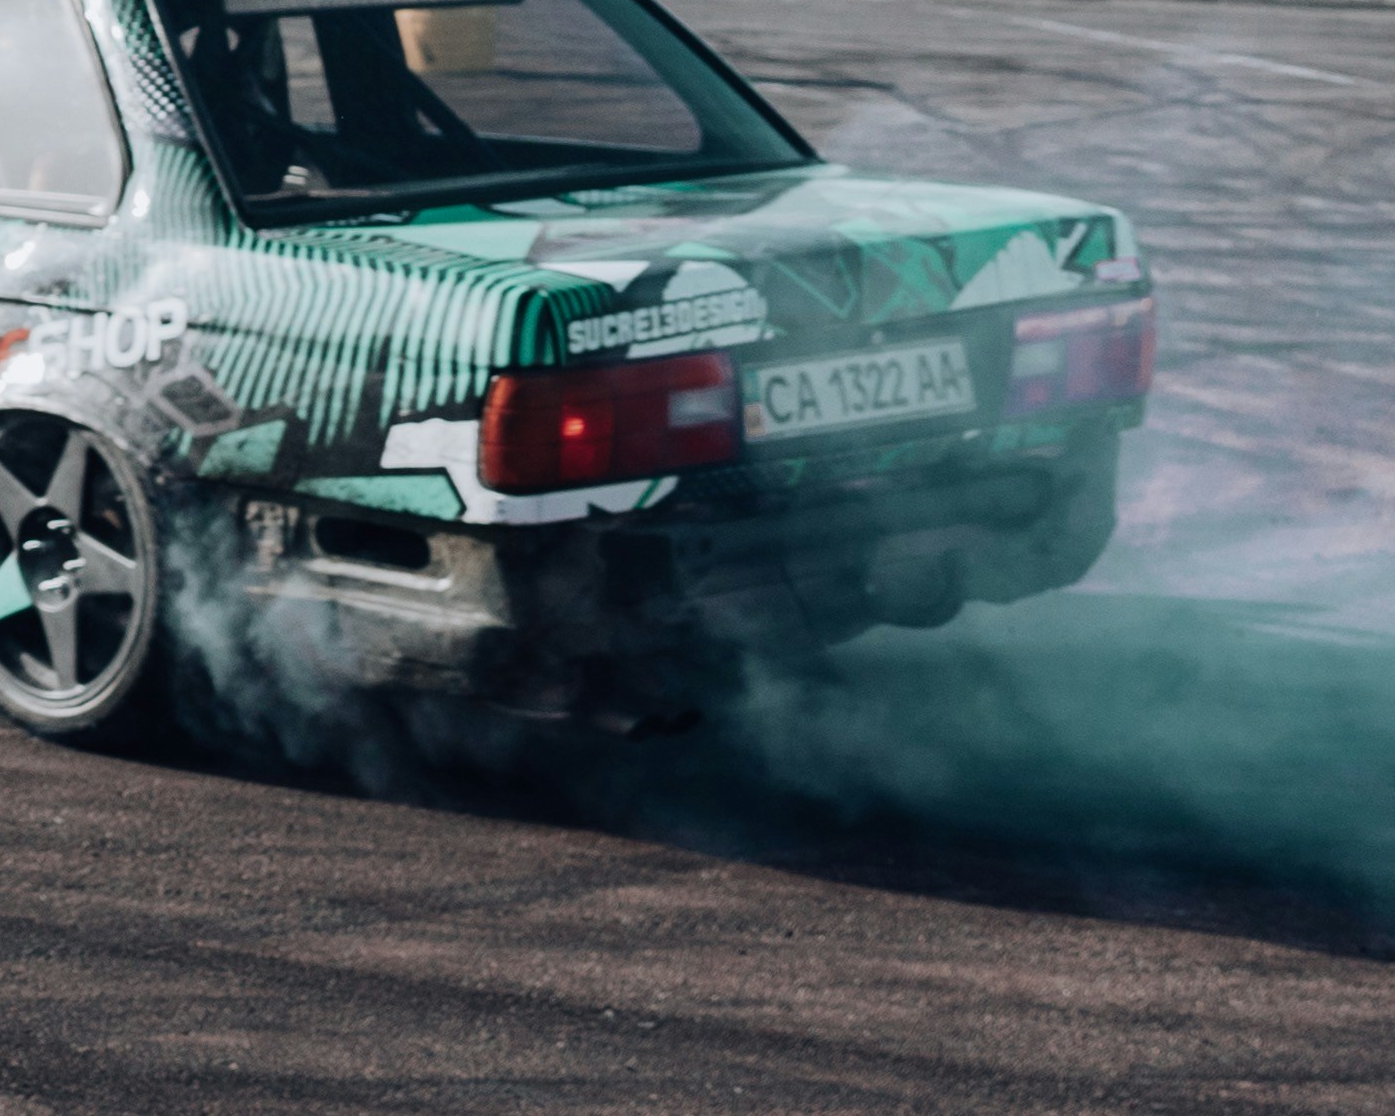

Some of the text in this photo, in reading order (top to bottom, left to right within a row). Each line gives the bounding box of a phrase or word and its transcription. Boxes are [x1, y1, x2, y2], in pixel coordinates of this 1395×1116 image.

[764, 350, 963, 423] CA 1322 AA
